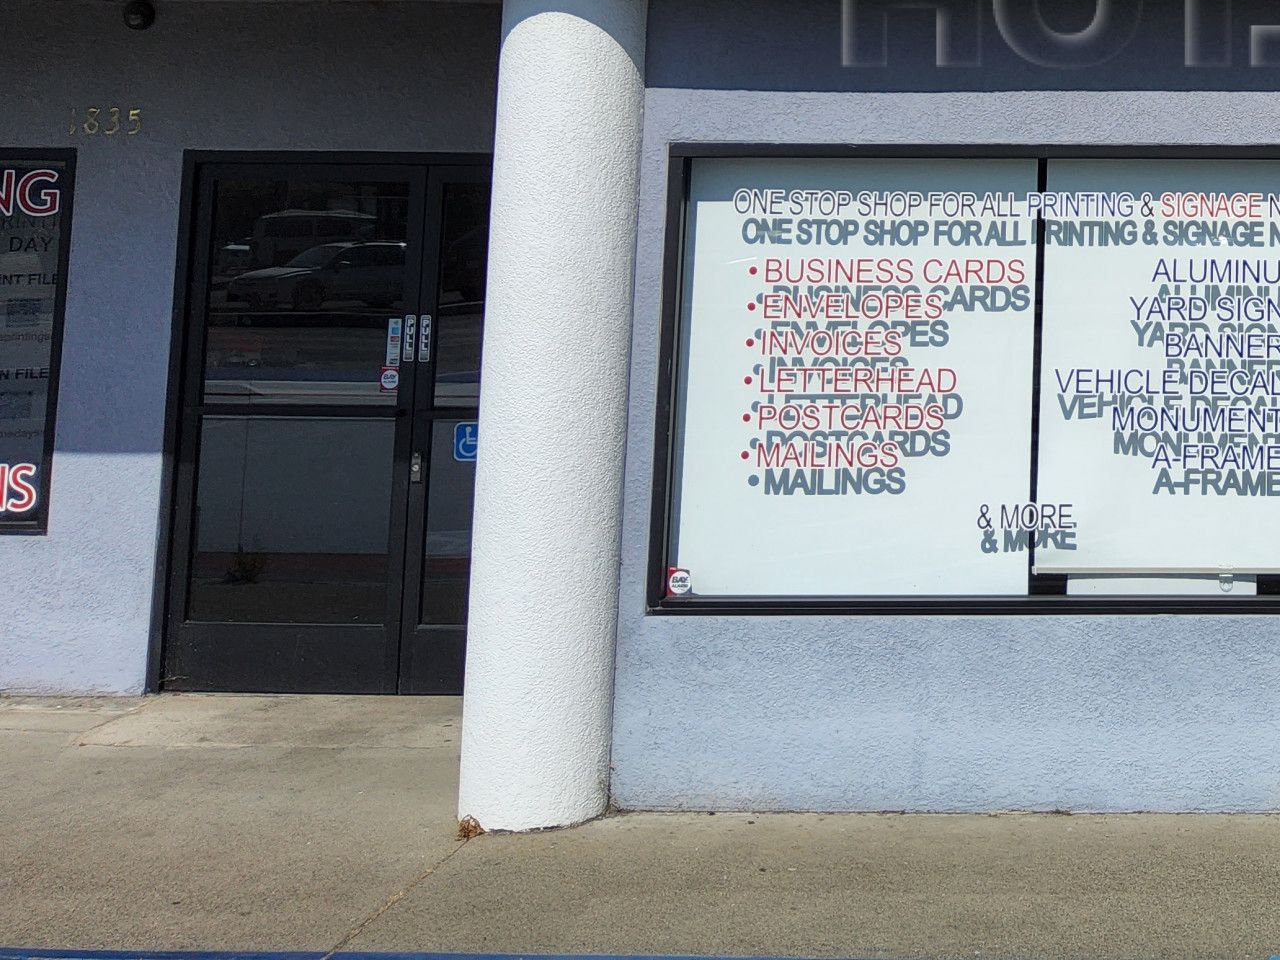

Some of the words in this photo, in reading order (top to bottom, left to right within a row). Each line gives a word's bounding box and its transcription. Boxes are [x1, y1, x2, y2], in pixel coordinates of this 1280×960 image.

[69, 107, 141, 134] 1835
[734, 189, 784, 215] ONE
[789, 190, 851, 216] STOP
[857, 191, 922, 217] SHOP
[928, 192, 976, 217] FOR
[980, 192, 1021, 217] ALL
[1027, 192, 1134, 217] PRINTING
[1140, 193, 1155, 218] &
[1160, 192, 1263, 219] SIGNAGE
[764, 258, 914, 283] BUSINESS
[923, 258, 1026, 284] CARDS
[762, 294, 943, 319] ENVELOPES
[1129, 296, 1208, 321] YARD
[405, 319, 413, 351] PULL
[421, 319, 429, 351] PULL
[760, 330, 902, 356] INVOICES
[759, 368, 957, 393] LETTERHEAD
[1054, 368, 1180, 395] VEHICLE
[757, 405, 945, 431] POSTCARDS
[756, 442, 899, 468] MAILINGS
[977, 503, 993, 530] &
[1000, 503, 1073, 529] MORE
